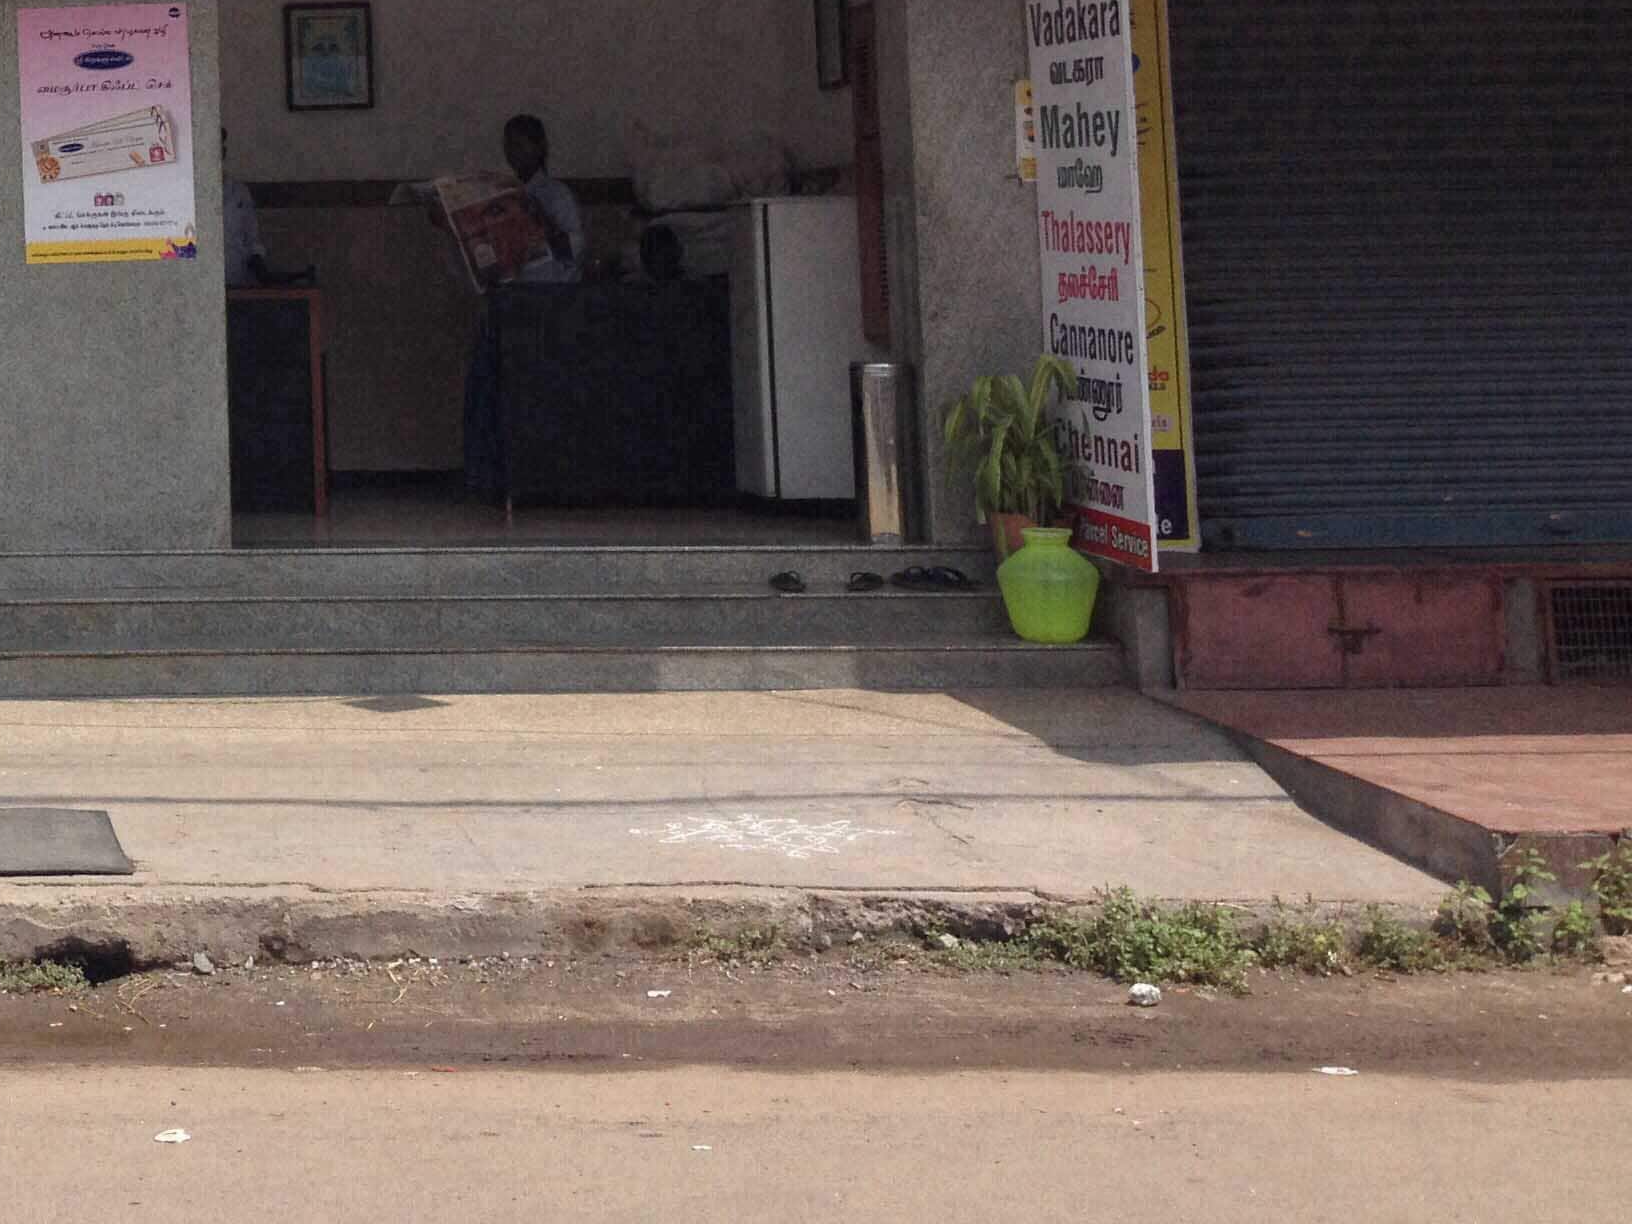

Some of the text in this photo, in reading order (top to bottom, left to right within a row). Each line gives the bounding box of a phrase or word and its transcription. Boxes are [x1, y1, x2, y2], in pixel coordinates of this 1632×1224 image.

[1040, 102, 1120, 157] Mahey
[1041, 210, 1131, 265] Thalassery
[1049, 312, 1134, 365] Cannanore
[1111, 525, 1150, 558] Service
